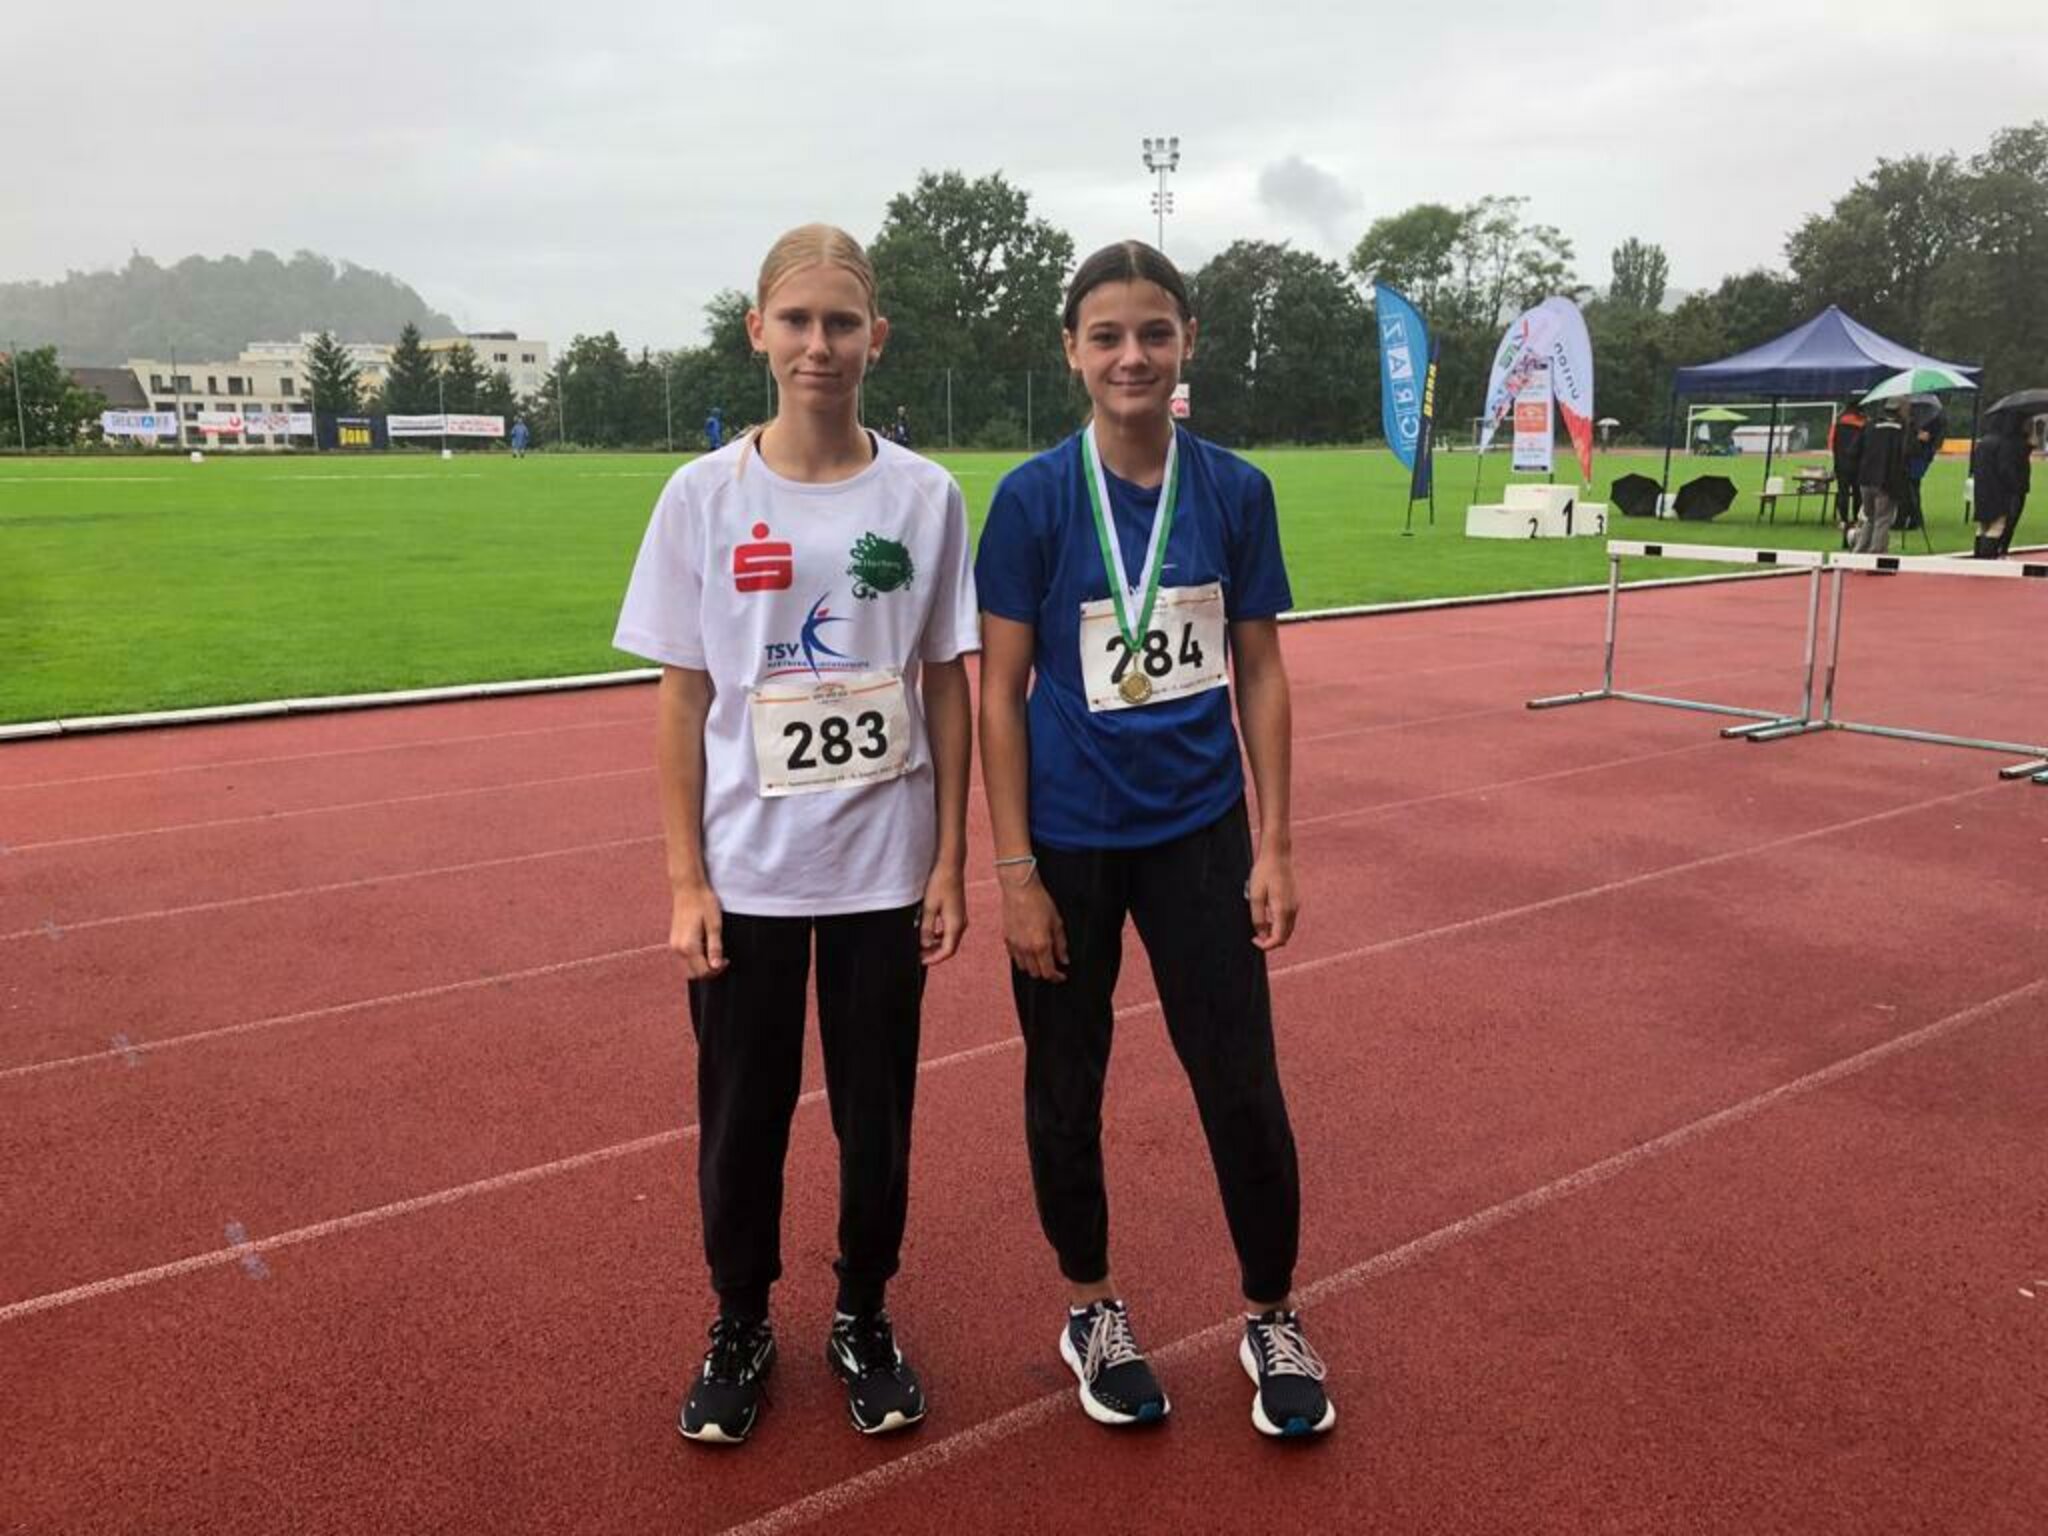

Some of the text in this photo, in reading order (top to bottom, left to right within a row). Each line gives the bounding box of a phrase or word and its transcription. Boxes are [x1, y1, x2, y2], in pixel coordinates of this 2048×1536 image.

[1528, 517, 1539, 539] 2
[1562, 498, 1574, 536] 1
[1594, 513, 1605, 536] 3
[764, 643, 800, 661] TSV
[1106, 621, 1203, 684] 284
[783, 711, 887, 770] 283
